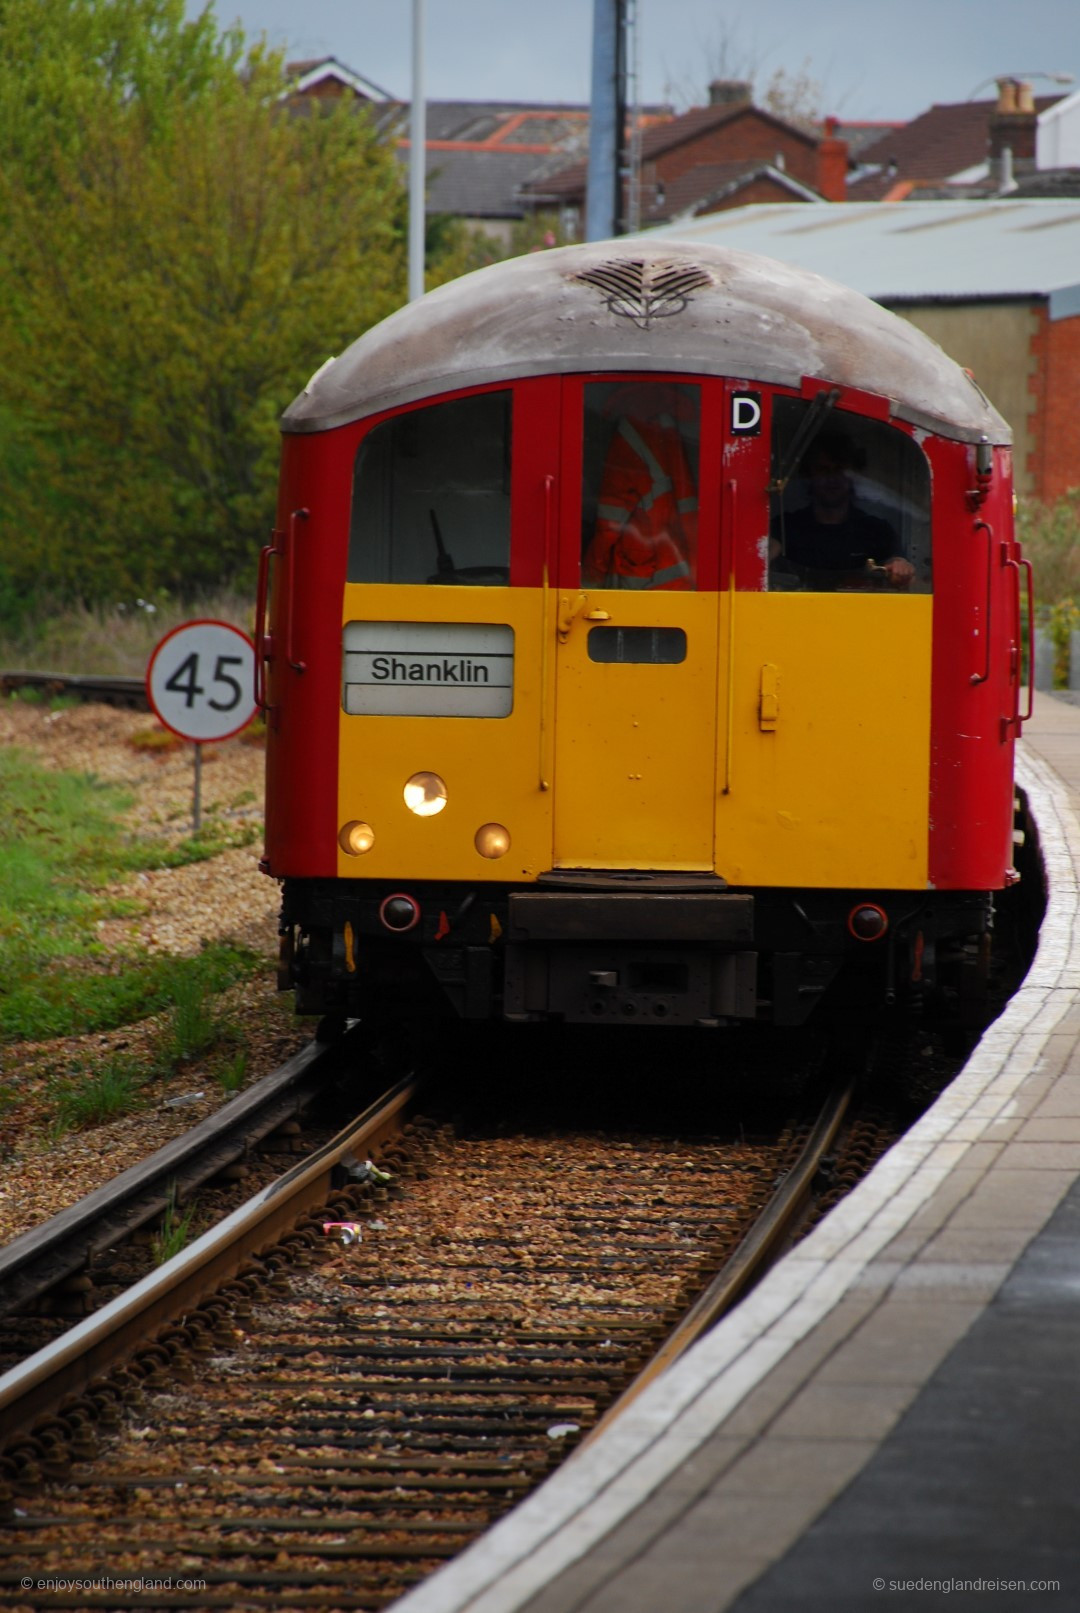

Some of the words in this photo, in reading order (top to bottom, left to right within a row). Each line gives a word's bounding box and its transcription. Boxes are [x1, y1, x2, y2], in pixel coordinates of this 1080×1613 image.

[732, 397, 761, 429] D
[165, 652, 242, 711] 45
[371, 656, 487, 683] Shanklin
